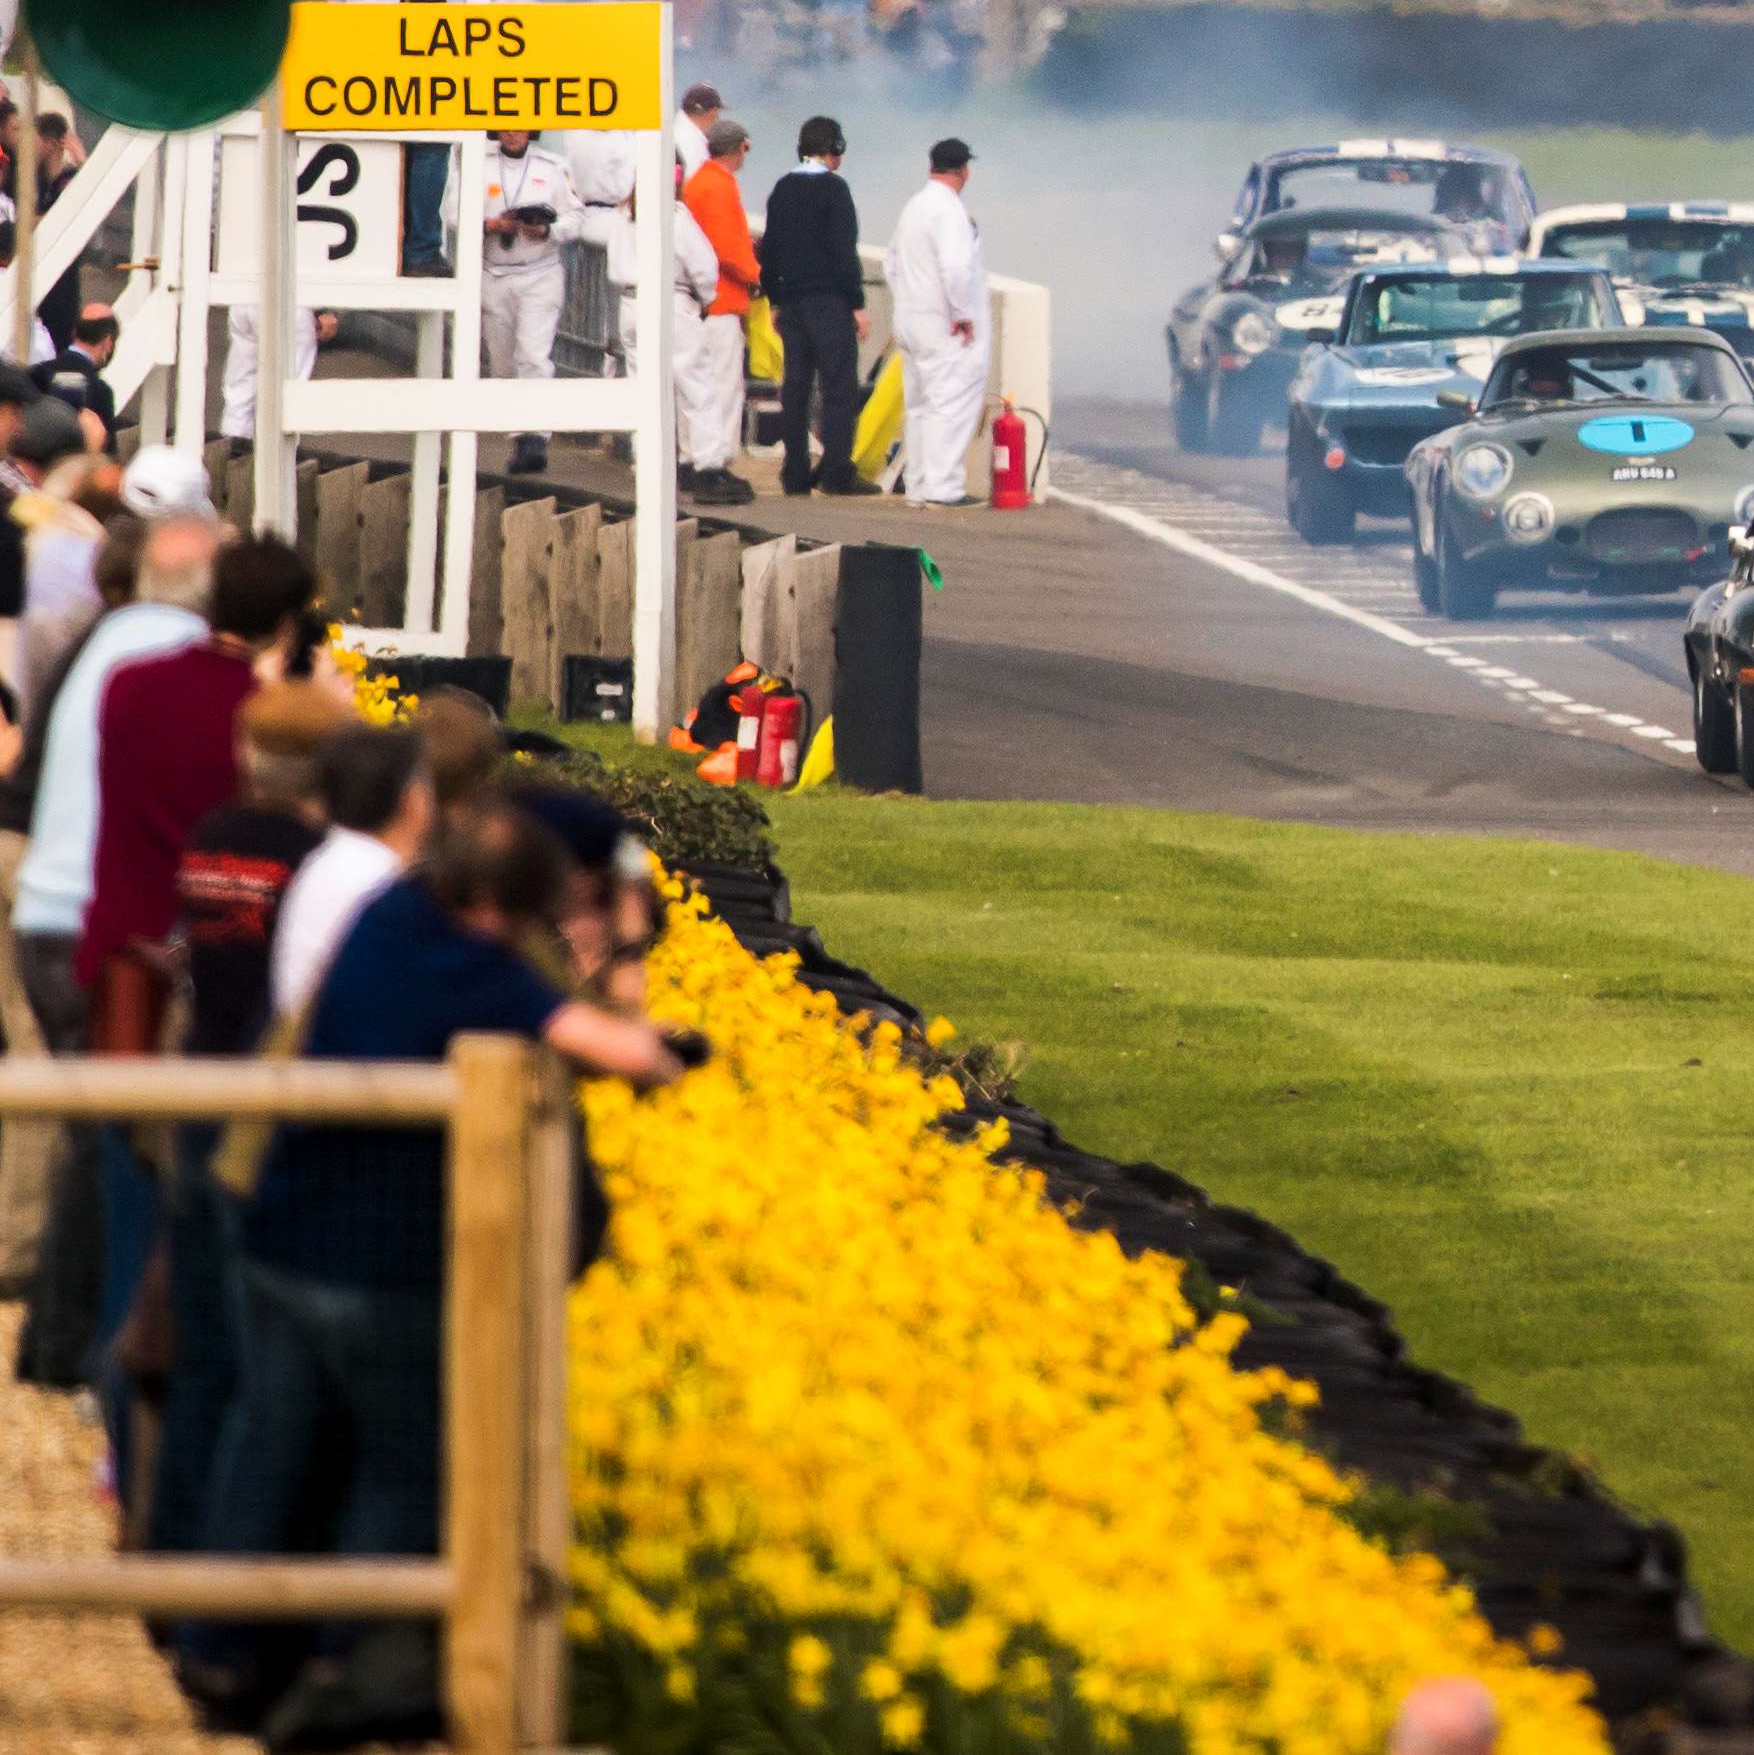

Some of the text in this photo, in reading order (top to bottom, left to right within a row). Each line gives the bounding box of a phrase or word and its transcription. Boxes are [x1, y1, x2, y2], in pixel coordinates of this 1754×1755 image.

[400, 17, 526, 57] LAPS
[304, 75, 618, 116] COMPLETED
[1630, 420, 1647, 442] 1
